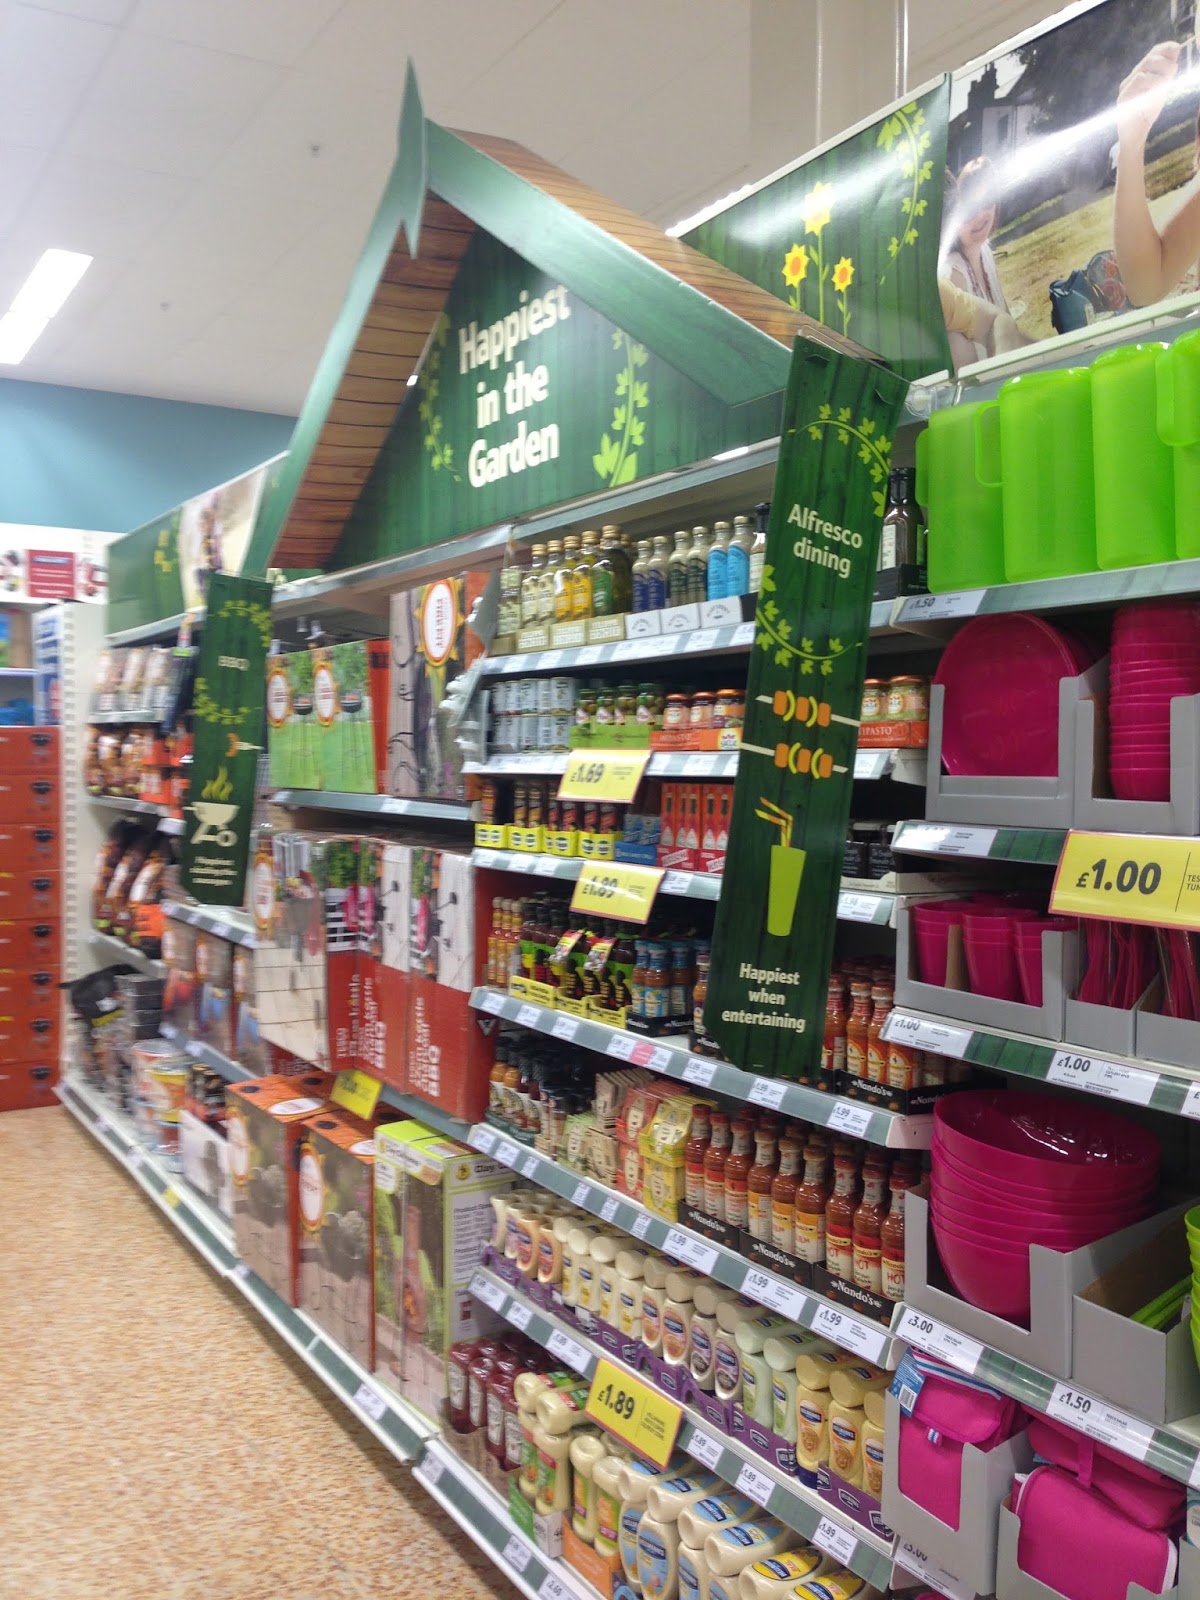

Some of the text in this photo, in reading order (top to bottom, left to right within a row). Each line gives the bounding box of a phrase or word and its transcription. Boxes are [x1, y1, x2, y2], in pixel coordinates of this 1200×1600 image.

[459, 285, 571, 374] Happiest
[476, 361, 549, 428] in the
[469, 420, 560, 487] Garden
[787, 504, 862, 548] Alfresco
[793, 537, 851, 578] dining
[910, 597, 936, 609] £1.50
[1076, 858, 1161, 895] £1.00
[739, 963, 800, 985] Happiest
[748, 988, 785, 1005] when
[722, 1008, 806, 1033] entertaining
[1057, 1055, 1091, 1072] £1.00
[857, 1079, 886, 1096] Nando's
[758, 1243, 791, 1265] Nando's
[837, 1280, 873, 1306] Nando's
[819, 1310, 842, 1326] £1.99
[908, 1316, 934, 1333] £3.00
[597, 1384, 635, 1420] £1.89
[1059, 1392, 1091, 1413] £1.50
[819, 1523, 836, 1538] £1.89
